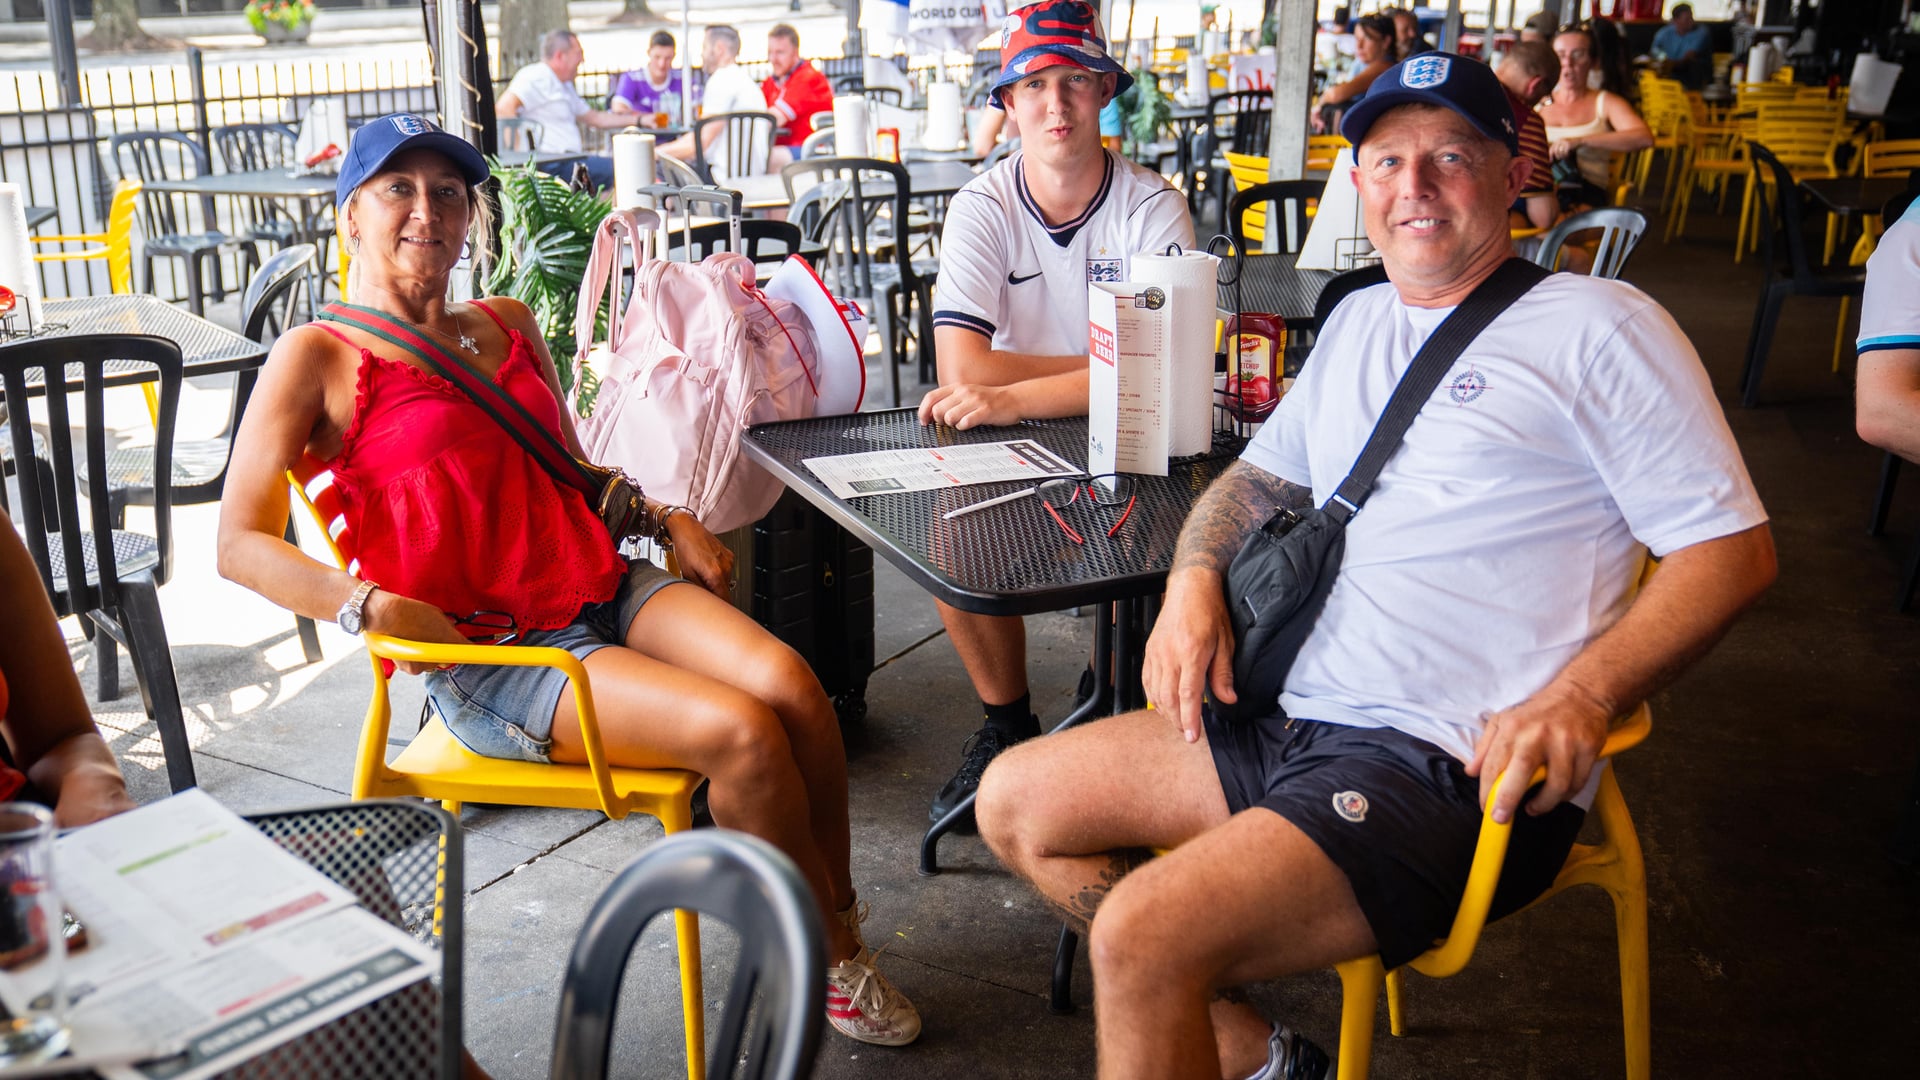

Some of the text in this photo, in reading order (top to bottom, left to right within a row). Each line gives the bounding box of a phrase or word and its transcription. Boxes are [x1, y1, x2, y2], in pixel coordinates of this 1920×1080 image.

[909, 7, 957, 19] WORLD
[1091, 326, 1112, 348] DRAFT
[1095, 342, 1114, 363] BEER
[1240, 362, 1260, 370] ETCHUP
